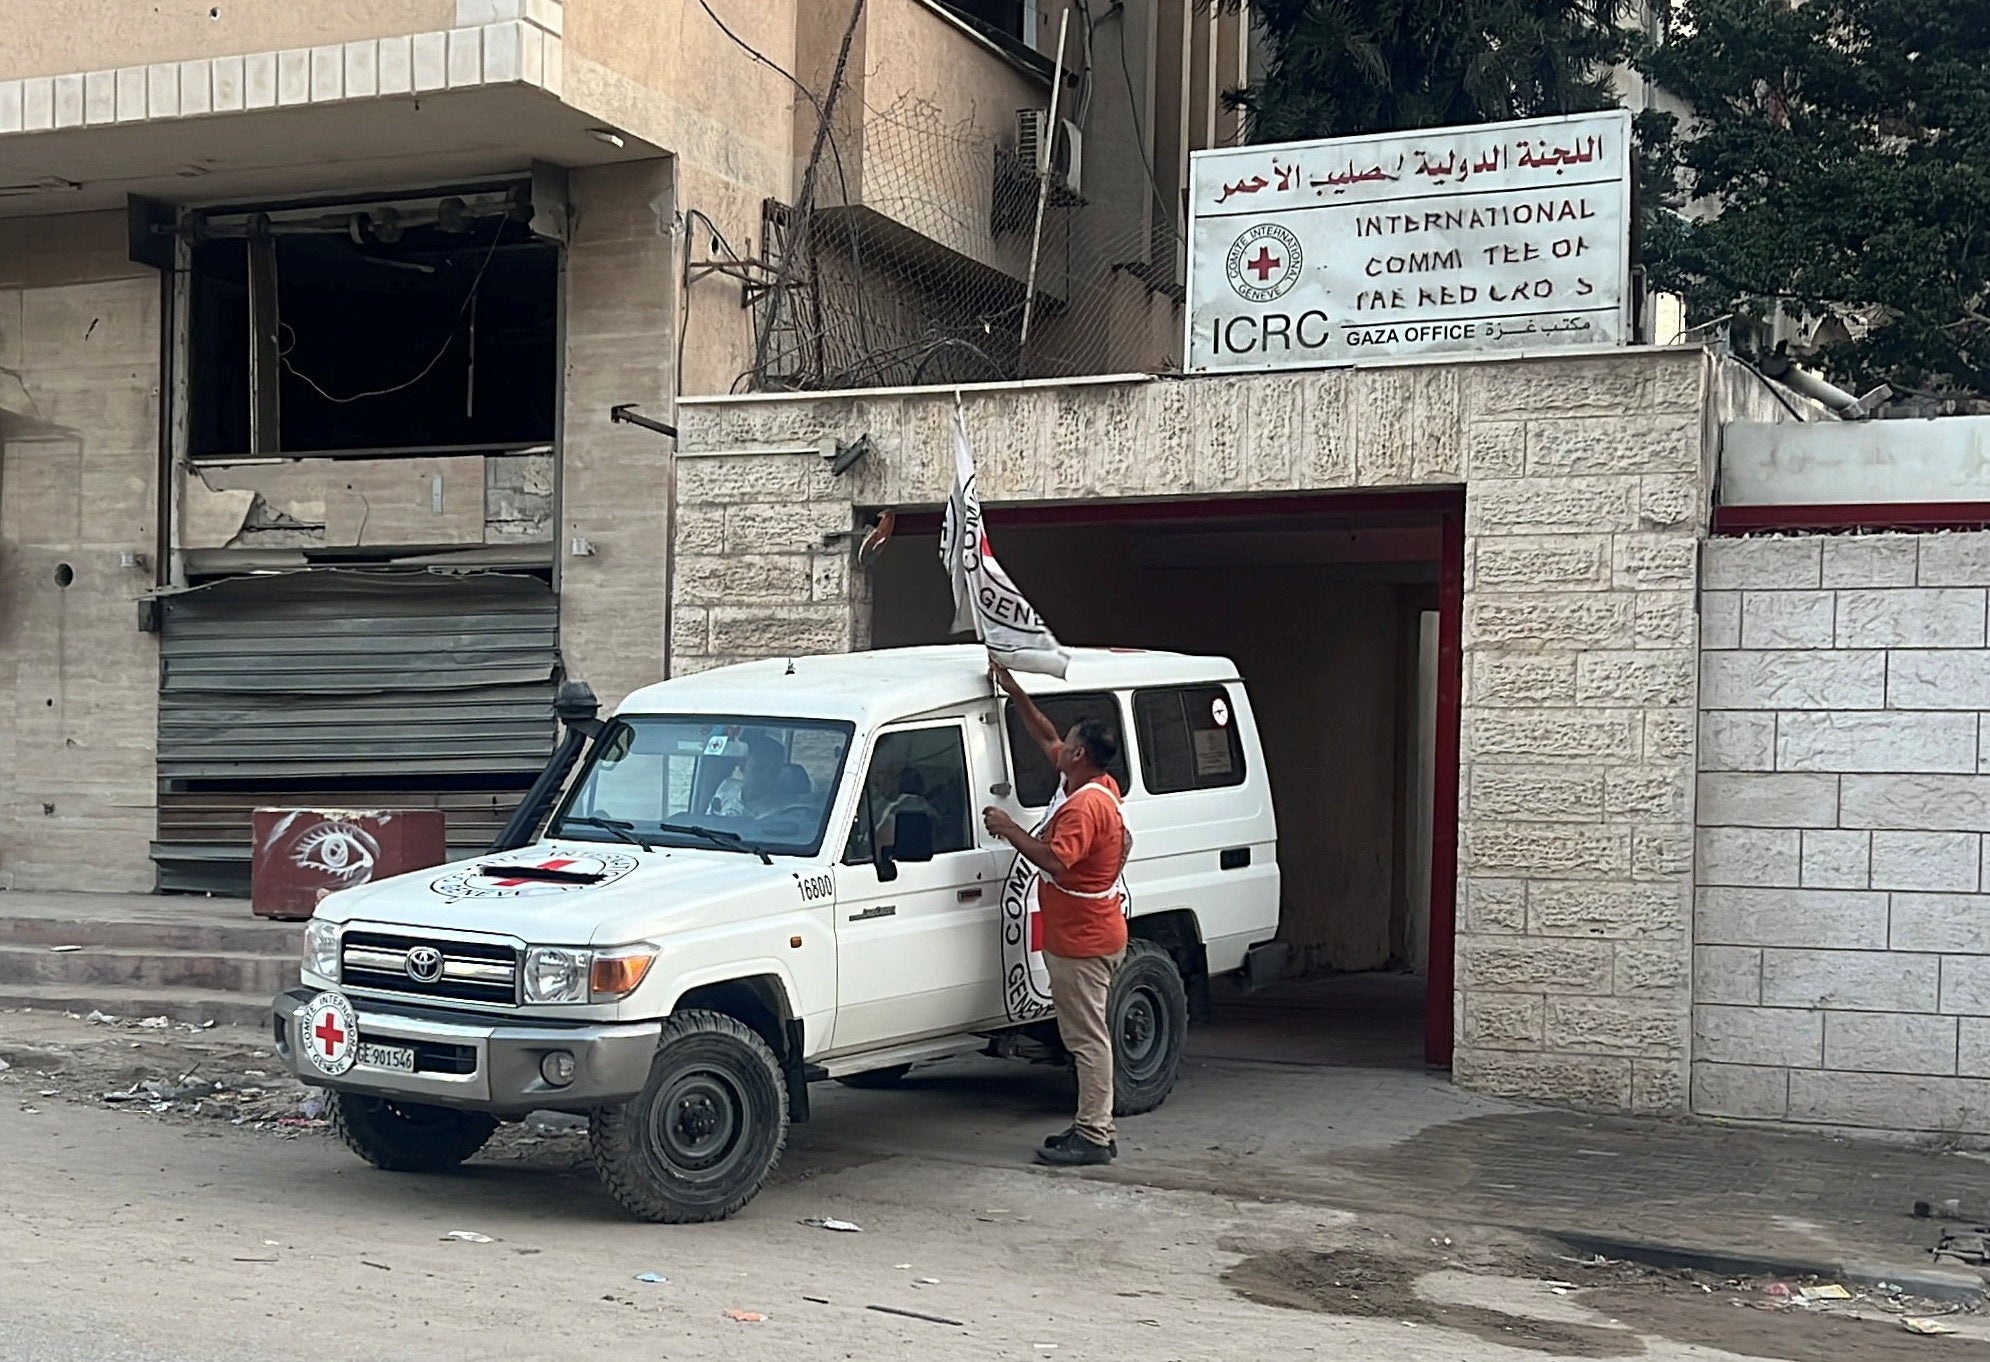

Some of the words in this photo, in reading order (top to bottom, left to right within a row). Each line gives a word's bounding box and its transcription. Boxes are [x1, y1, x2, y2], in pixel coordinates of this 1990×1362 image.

[1413, 144, 1508, 186] الدولية
[1516, 134, 1602, 176] اللجنة
[1214, 157, 1301, 204] الأحمر
[1356, 198, 1596, 237] INTERNATIONAL
[1249, 226, 1301, 282] INTERNATIONAL
[1238, 283, 1282, 300] GENEVE
[1213, 309, 1329, 355] ICRC
[1346, 328, 1399, 346] GAZA
[1404, 324, 1475, 342] OFFICE
[1541, 316, 1591, 337] مكتب
[798, 874, 833, 901] 16800
